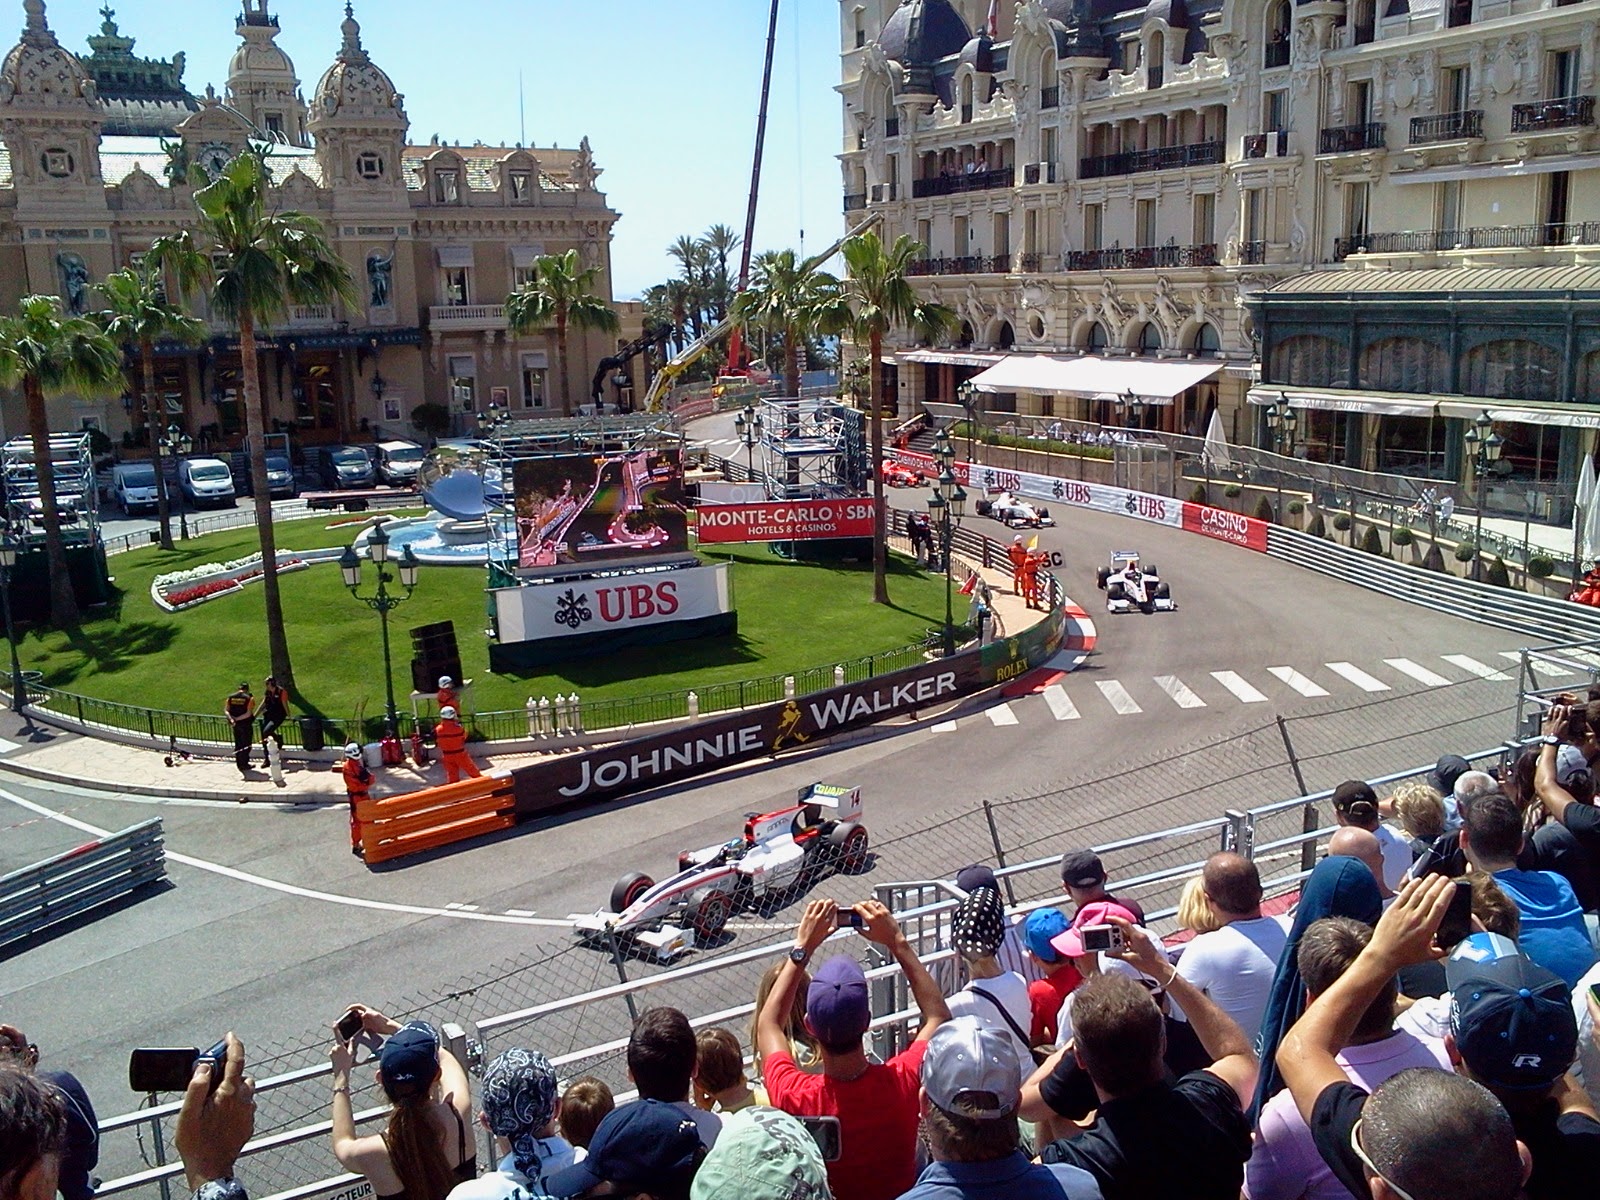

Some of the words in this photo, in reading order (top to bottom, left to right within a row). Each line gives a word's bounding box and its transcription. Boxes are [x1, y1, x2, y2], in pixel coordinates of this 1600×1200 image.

[996, 471, 1021, 491] UBS
[1065, 482, 1091, 504] UBS
[700, 506, 833, 527] MONTE-CARLO
[1138, 495, 1166, 520] UBS
[748, 525, 784, 535] HOTELS
[786, 525, 793, 533] &
[795, 522, 837, 533] CASINOS
[1200, 507, 1248, 534] CASINO
[1041, 552, 1063, 568] SC
[595, 580, 680, 623] UBS
[996, 657, 1029, 682] ROLEX
[558, 723, 764, 798] JOHNNIE
[810, 670, 958, 730] WALKER
[1512, 1054, 1542, 1068] R
[328, 1183, 372, 1200] CTEUR
